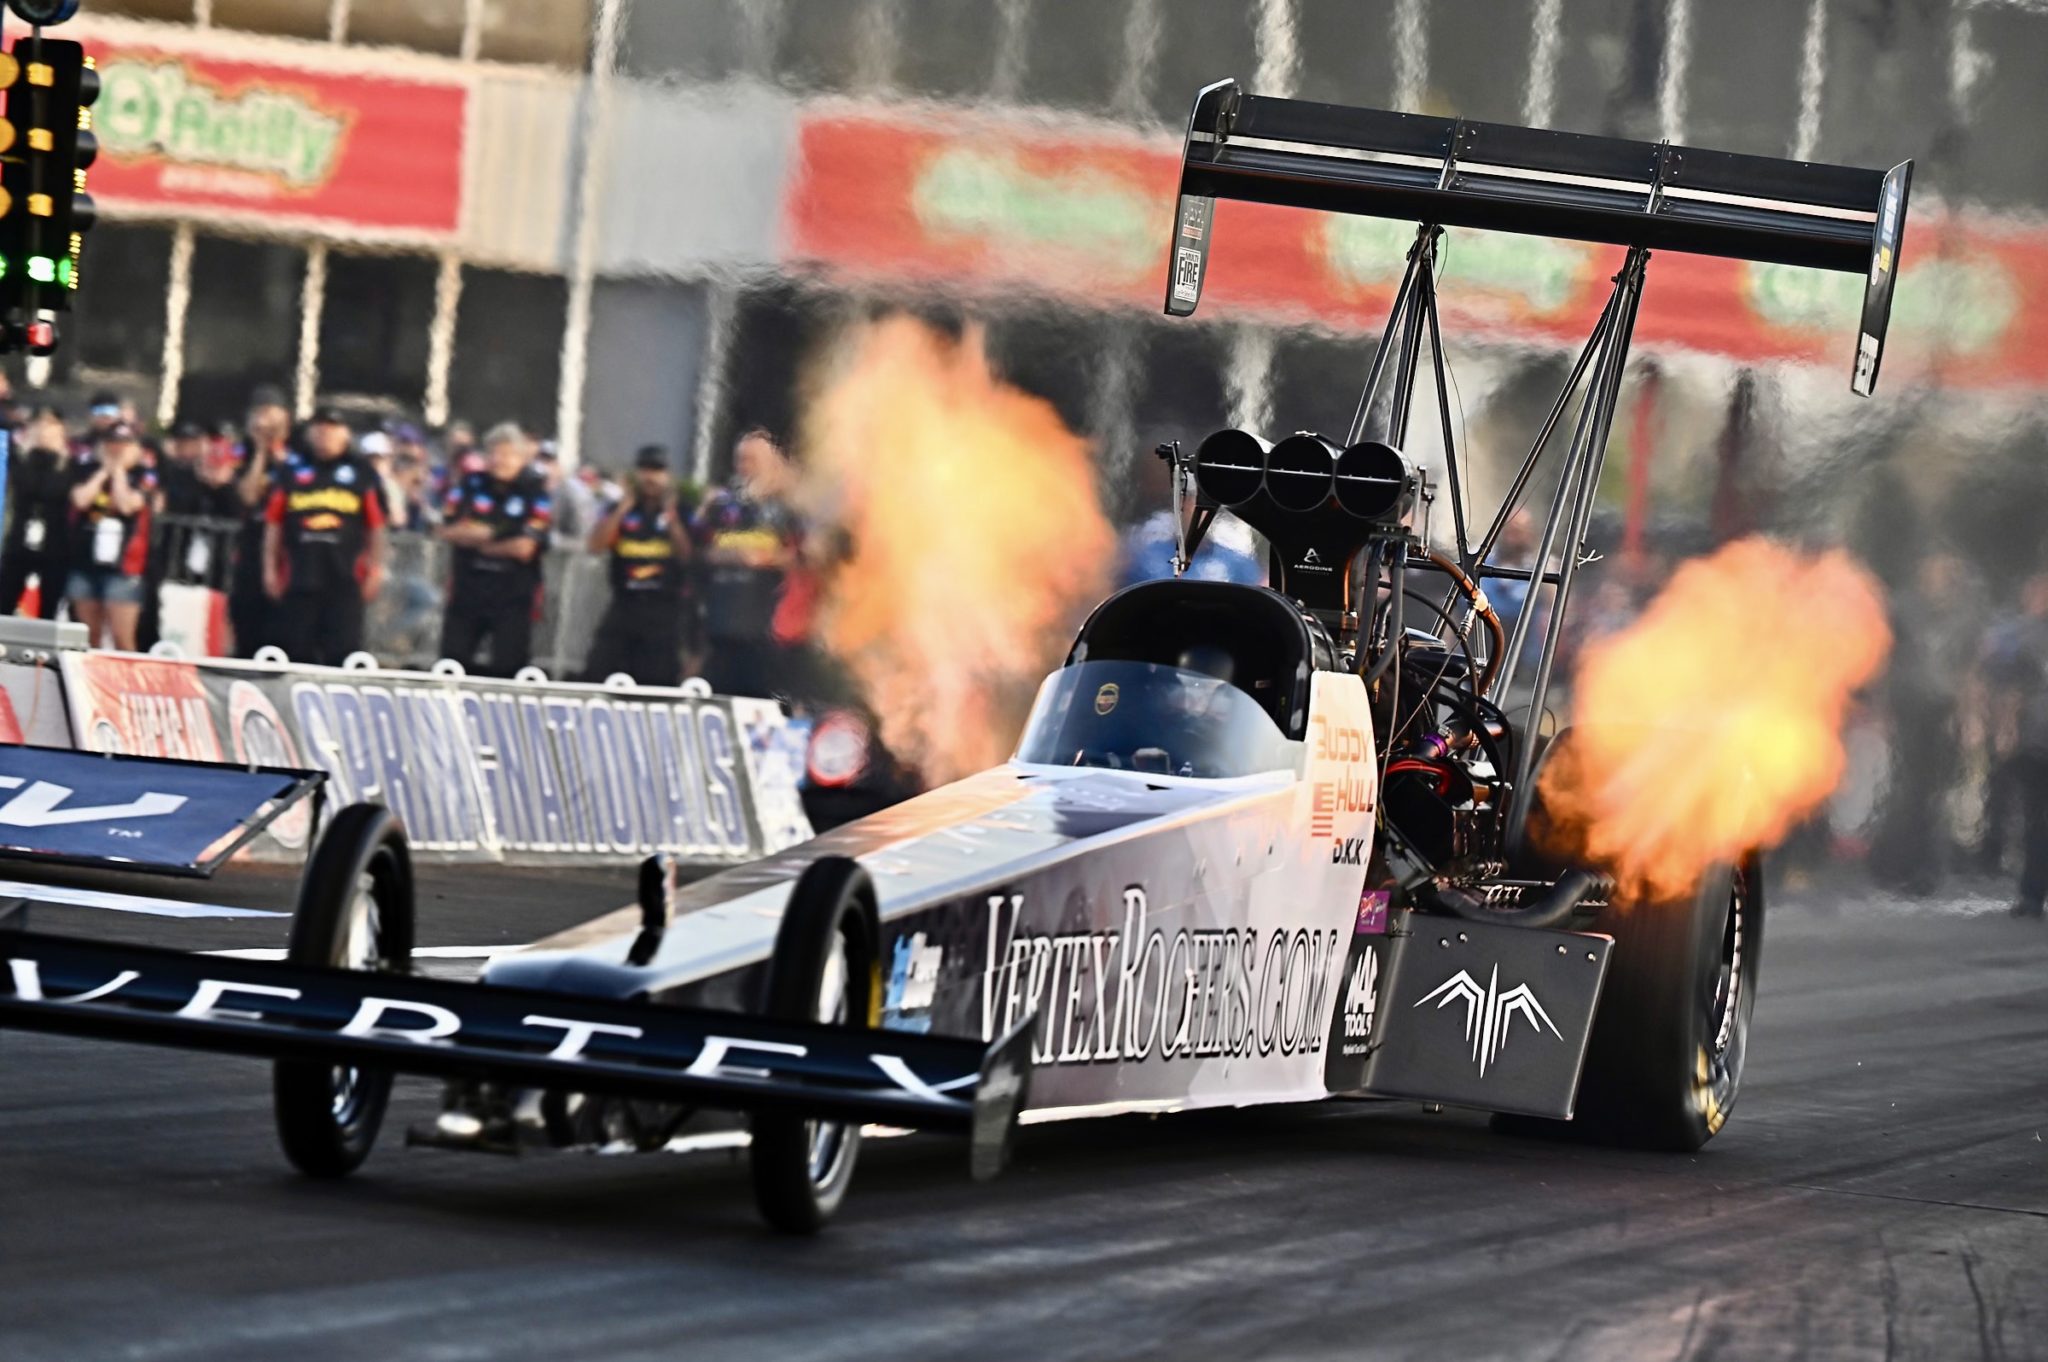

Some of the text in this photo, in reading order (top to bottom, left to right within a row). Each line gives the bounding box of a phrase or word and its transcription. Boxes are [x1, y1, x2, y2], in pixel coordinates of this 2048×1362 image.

[1177, 257, 1199, 287] FIRE
[1336, 765, 1374, 814] HULL
[1344, 945, 1378, 1014] MAC
[1344, 1013, 1373, 1037] TOOLS
